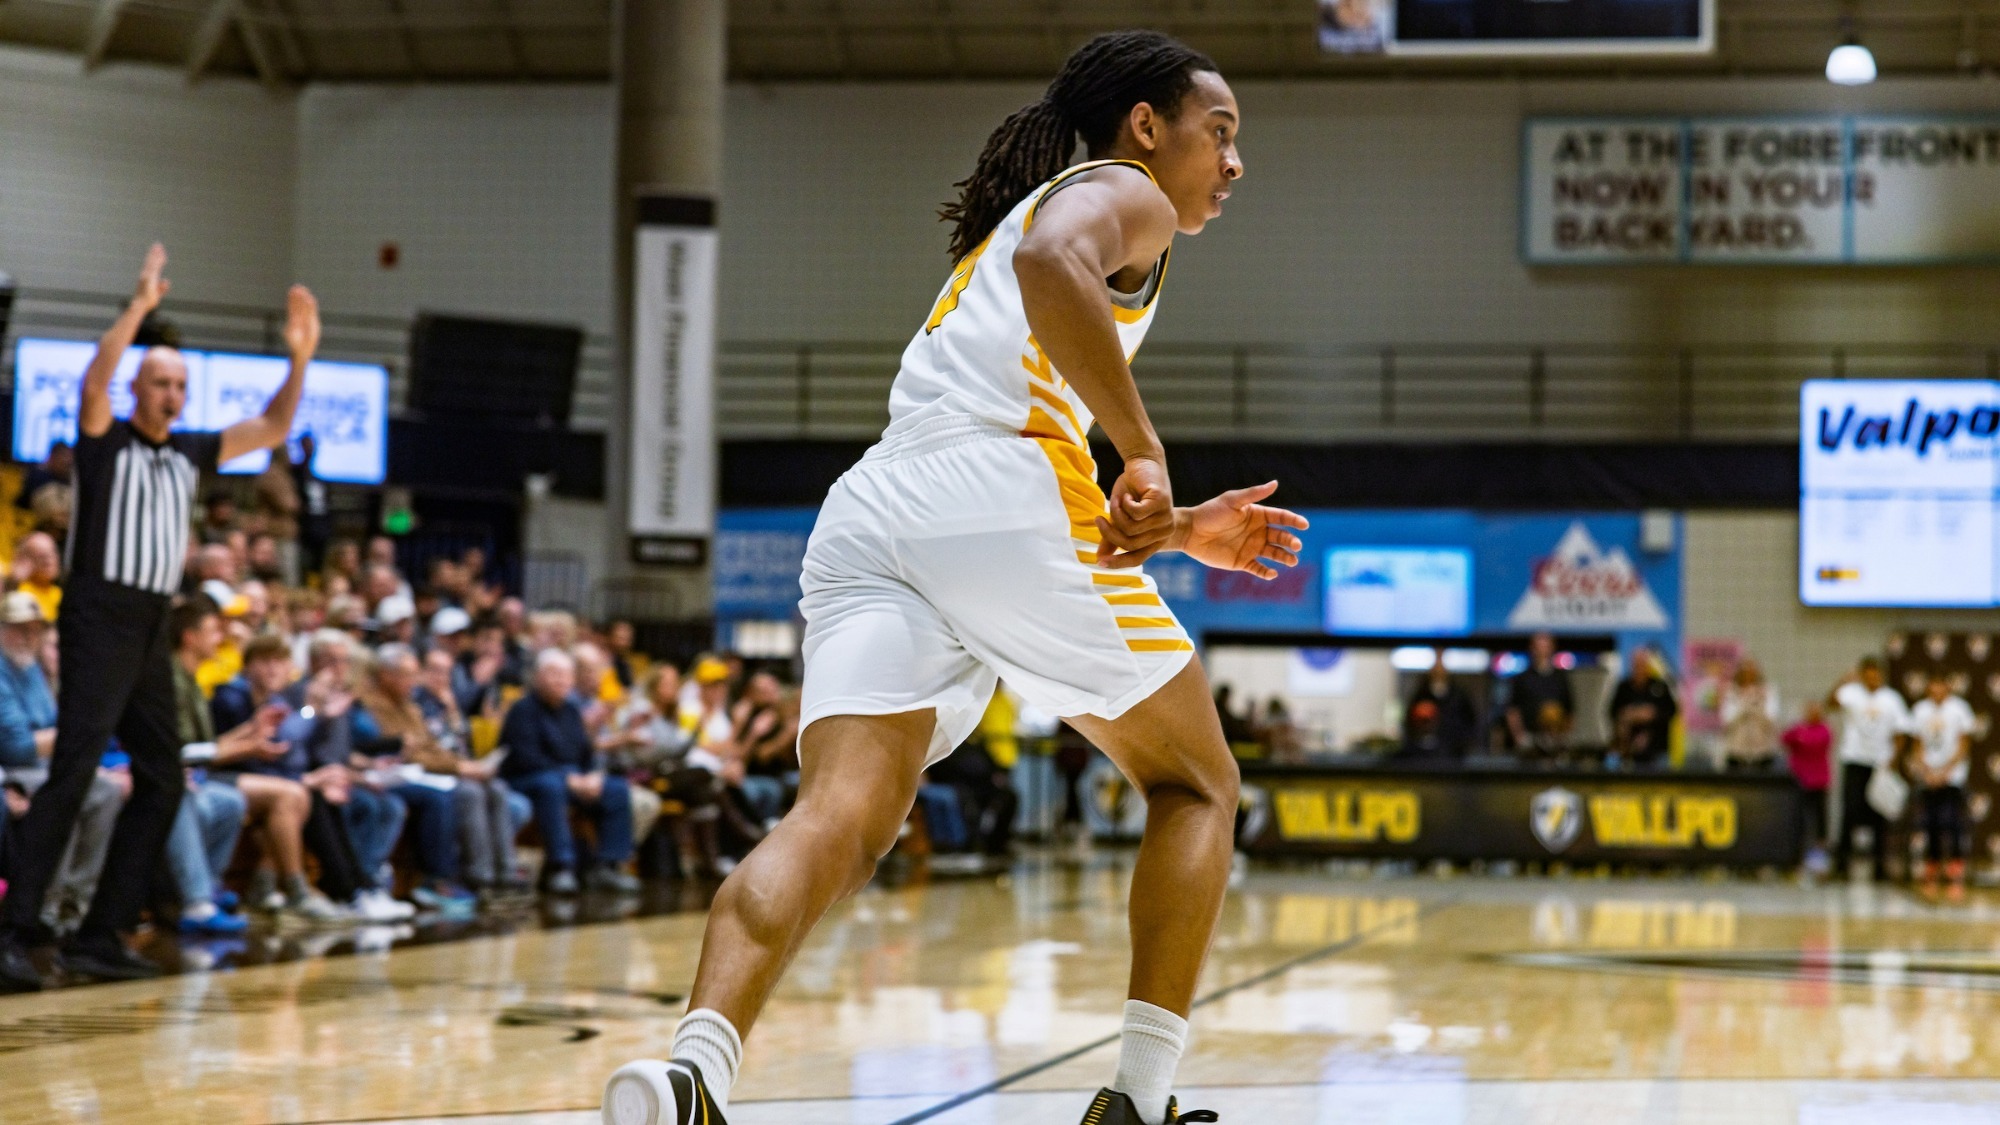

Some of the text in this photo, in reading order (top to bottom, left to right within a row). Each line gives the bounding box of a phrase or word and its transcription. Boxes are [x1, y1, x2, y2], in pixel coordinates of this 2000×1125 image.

[1553, 131, 1605, 163] AT
[1627, 131, 1709, 164] THE
[1553, 172, 1669, 206] NOW
[1743, 173, 1874, 208] YOUR
[1819, 397, 2000, 455] Valpo
[1531, 557, 1642, 597] Coors
[1543, 597, 1629, 618] LIGHT
[1275, 791, 1737, 848] VALPO VALPO
